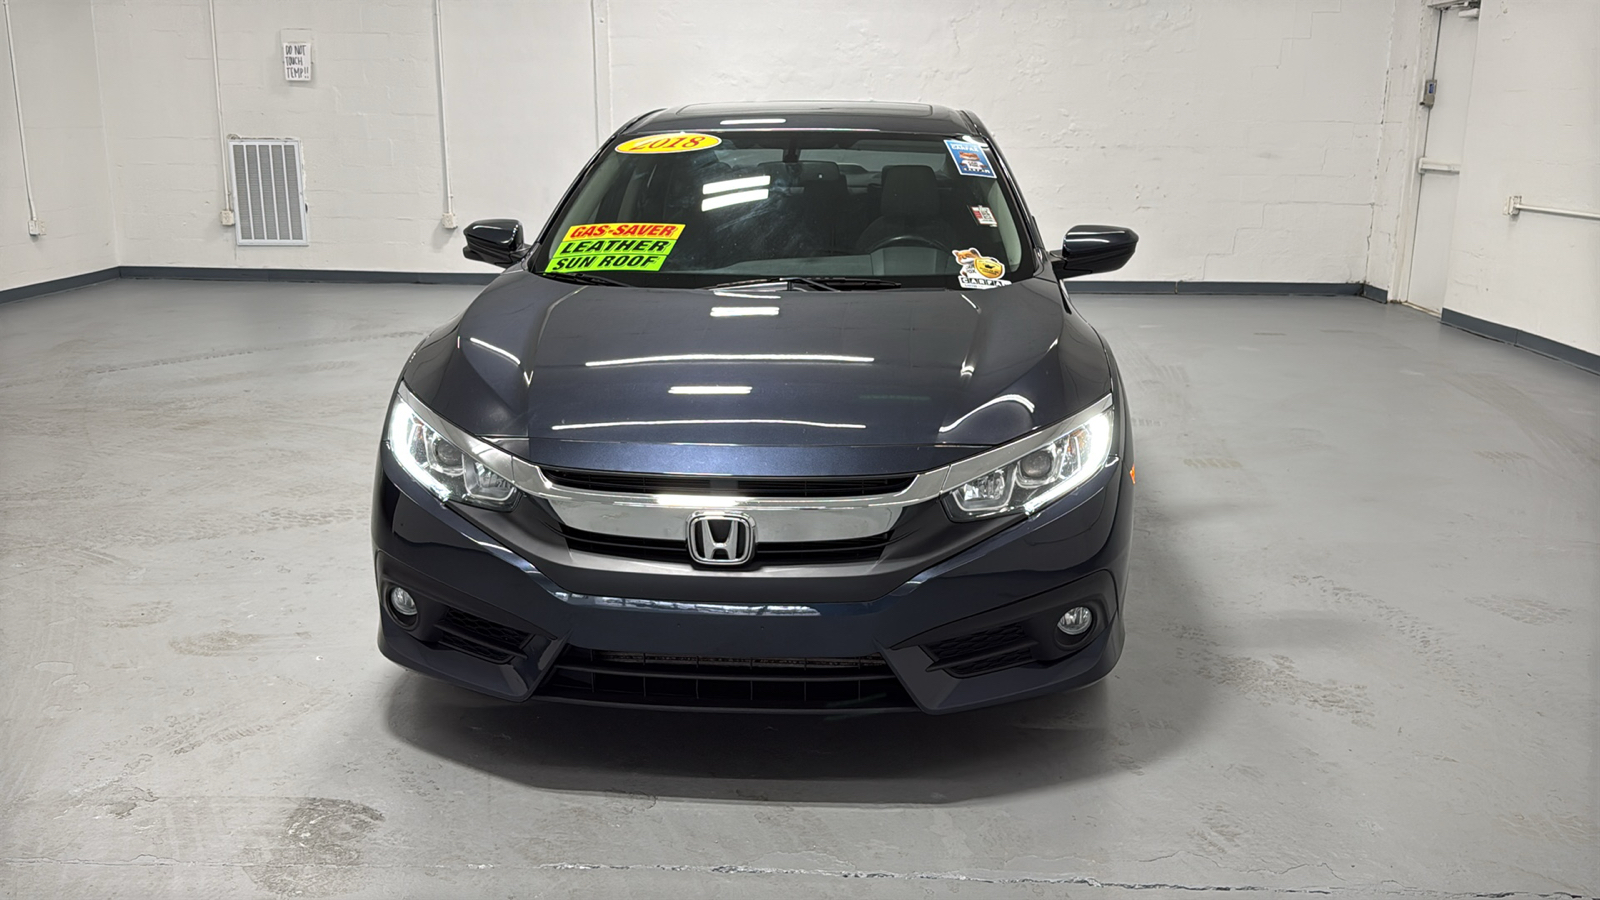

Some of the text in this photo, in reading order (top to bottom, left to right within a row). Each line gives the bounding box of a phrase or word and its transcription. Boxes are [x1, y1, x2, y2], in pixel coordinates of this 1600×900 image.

[285, 45, 306, 56] DO NOT
[285, 56, 303, 66] TOUCH
[286, 66, 309, 79] TEMP!!
[629, 136, 706, 151] 2018
[570, 225, 677, 238] GAS-SAVER
[561, 240, 670, 254] LEATHER
[552, 255, 659, 270] SUN ROOF
[960, 277, 1004, 287] CARFA
